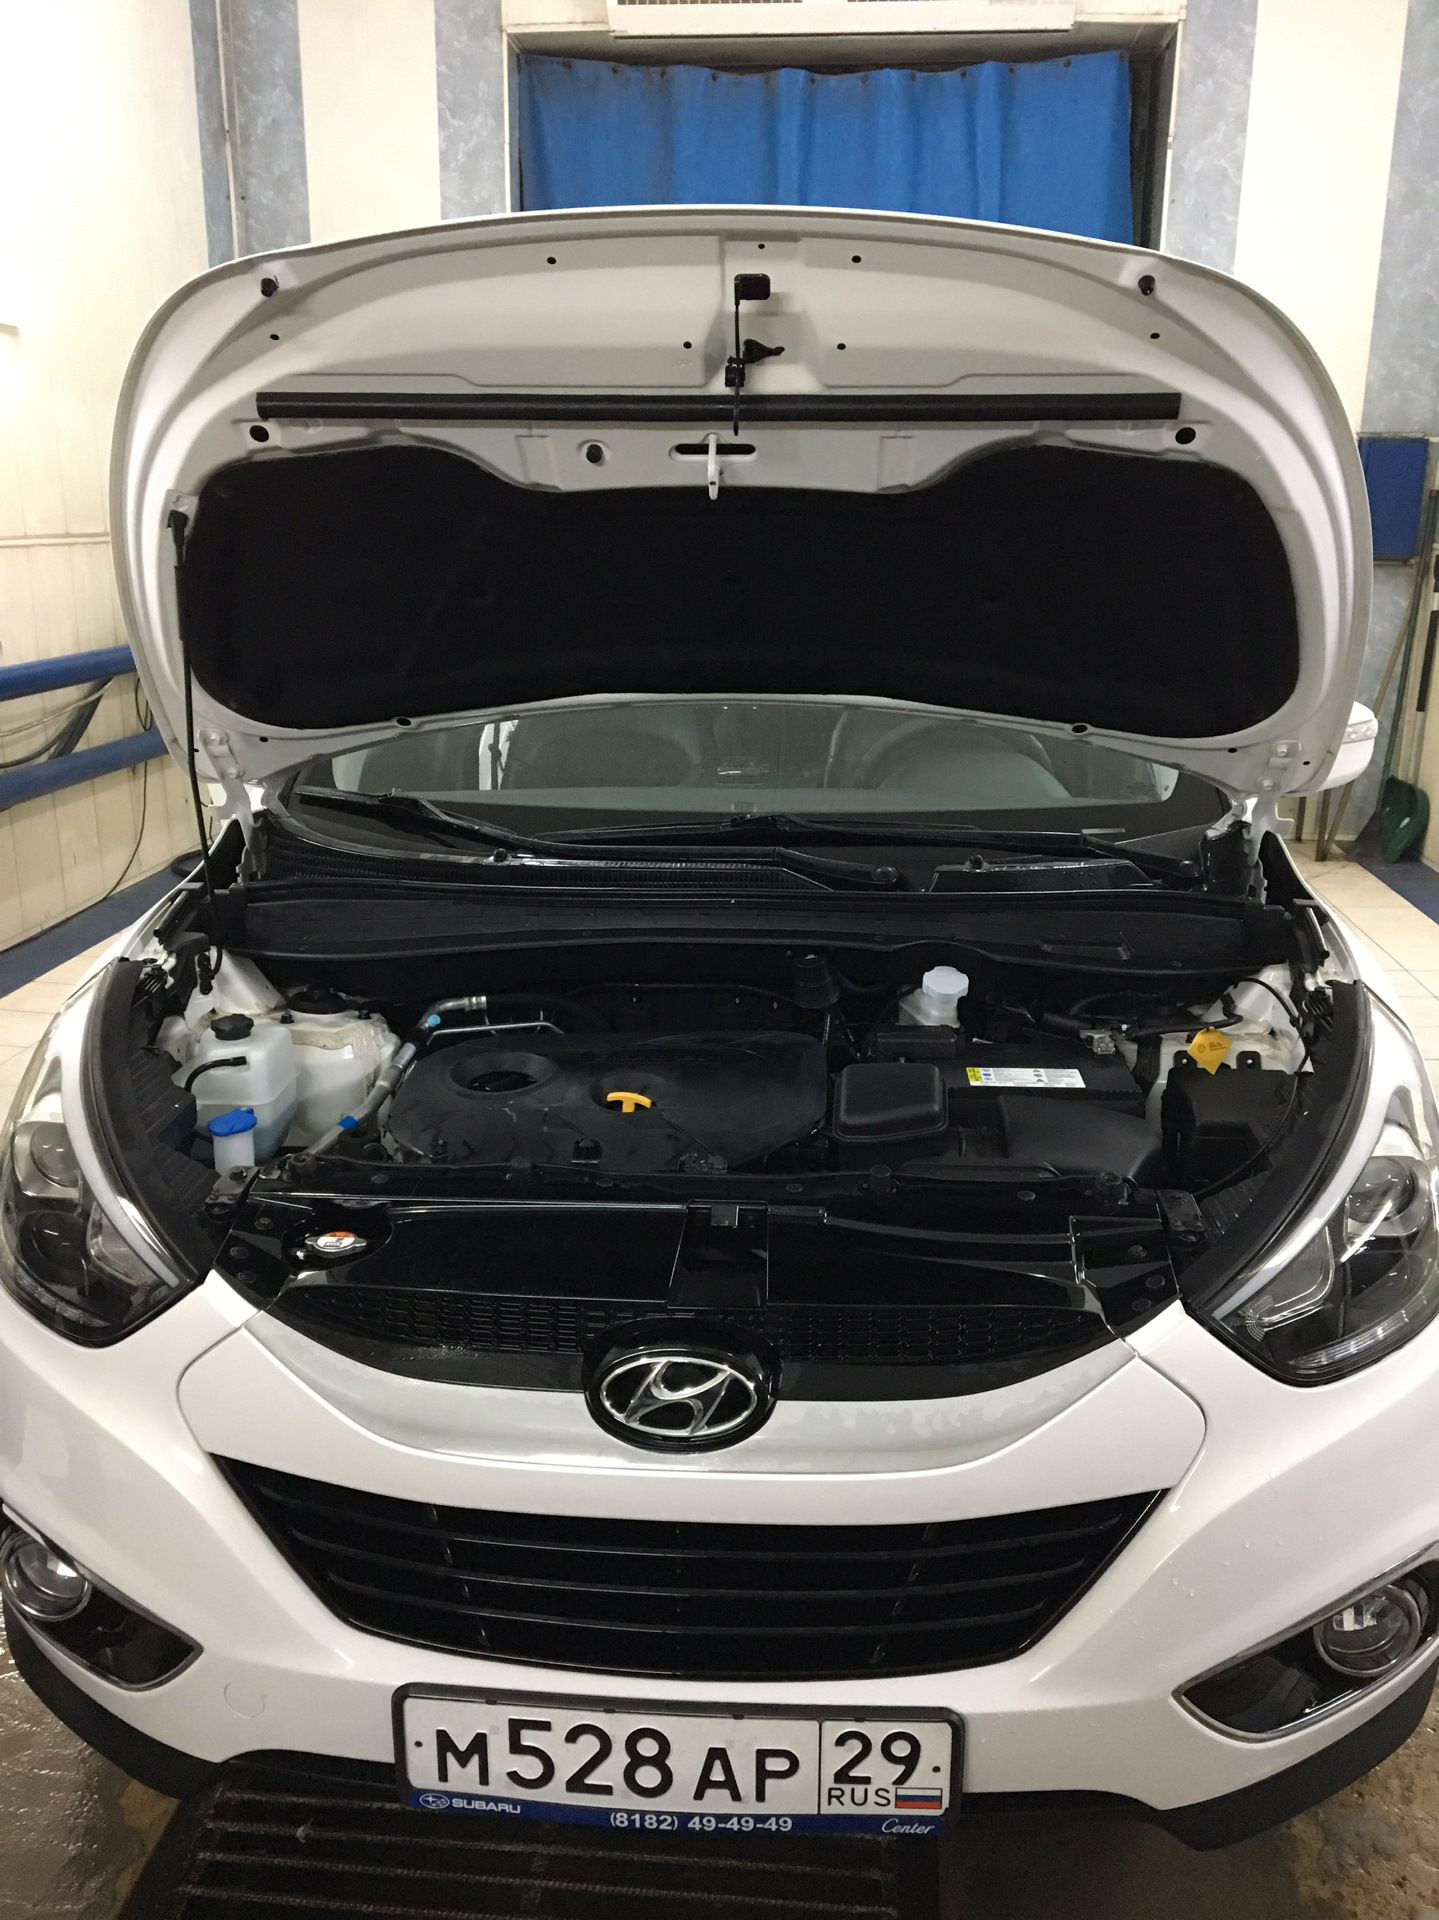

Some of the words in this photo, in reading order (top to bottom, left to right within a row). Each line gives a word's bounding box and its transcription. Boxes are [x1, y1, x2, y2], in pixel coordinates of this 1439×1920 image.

[834, 1730, 921, 1785] 29
[451, 1797, 521, 1814] SUBARU
[827, 1787, 892, 1806] RUS
[610, 1812, 679, 1831] (8182)
[687, 1815, 793, 1832] 49-49-49
[881, 1818, 936, 1834] Center
